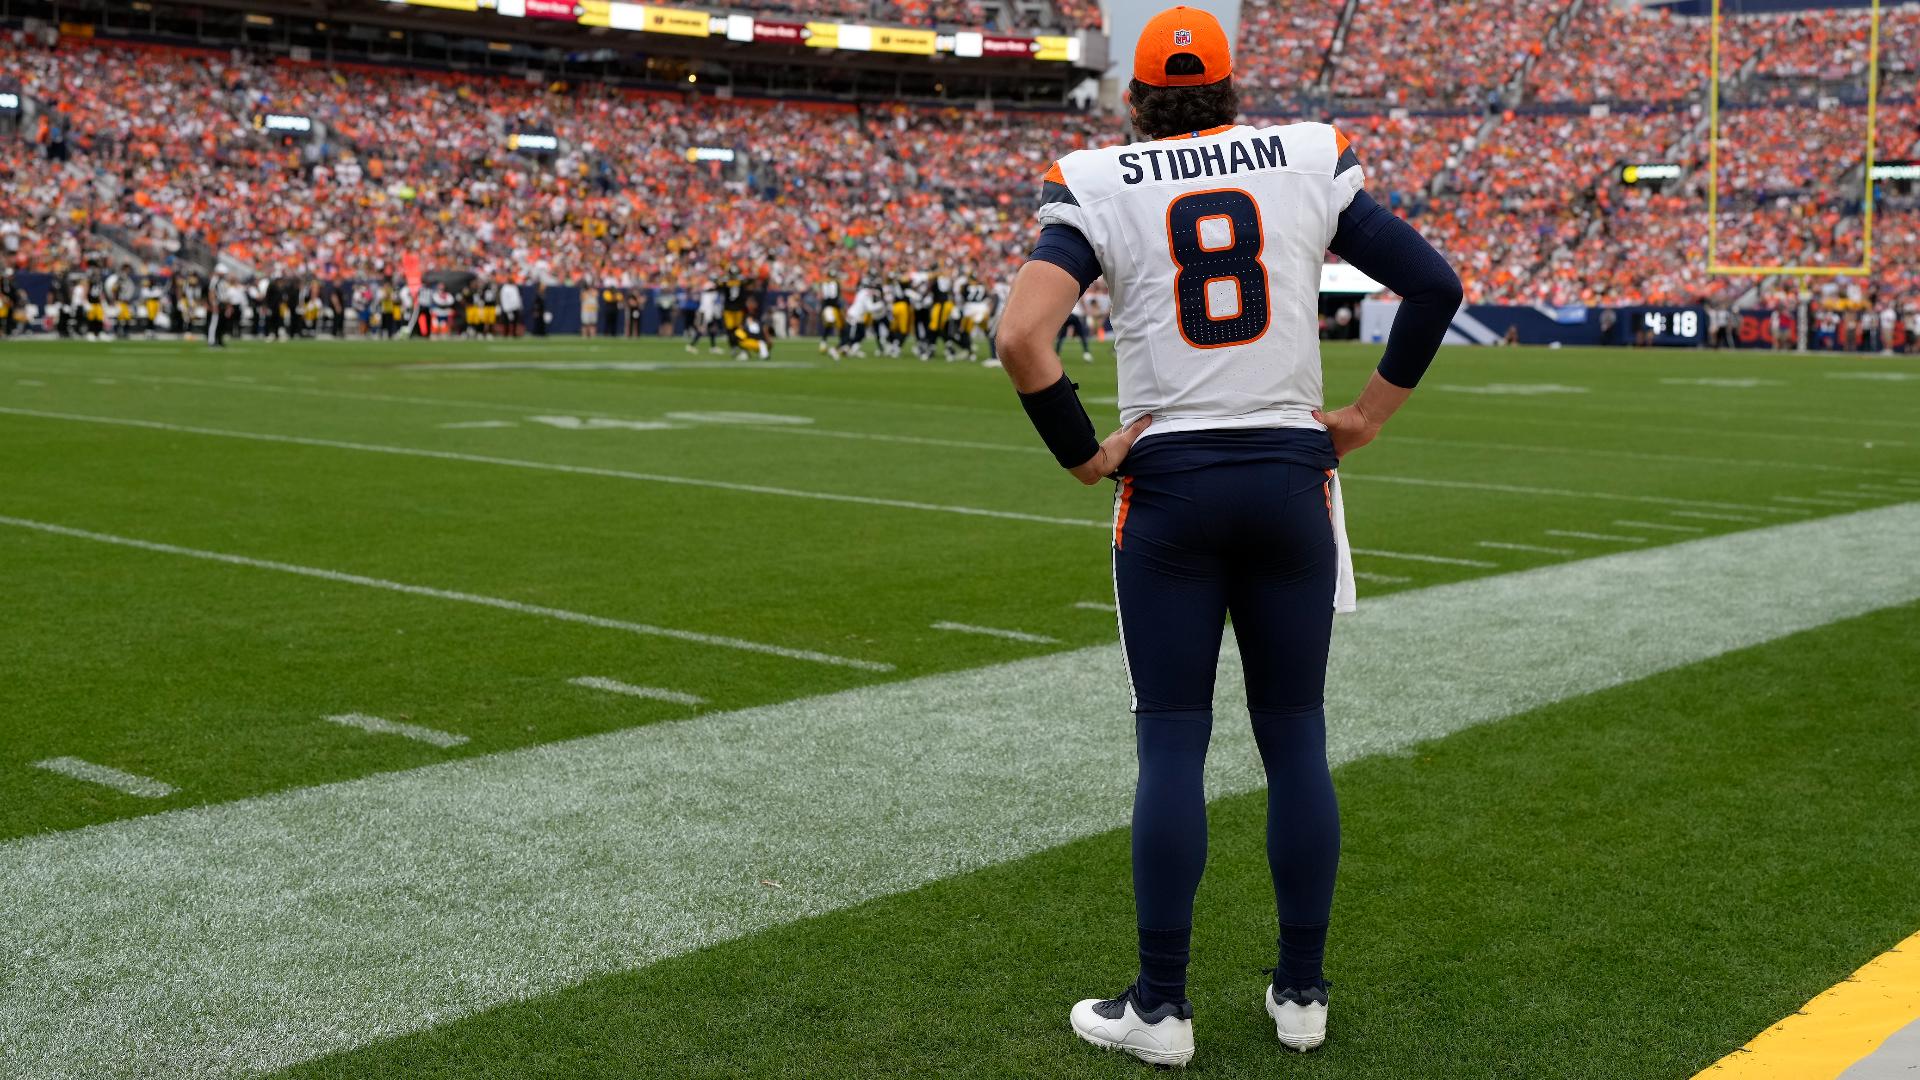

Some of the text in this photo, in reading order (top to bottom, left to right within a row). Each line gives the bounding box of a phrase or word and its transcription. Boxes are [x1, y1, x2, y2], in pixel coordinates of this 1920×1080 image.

[1119, 135, 1287, 185] STIDHAM
[1166, 187, 1271, 350] 8
[1645, 311, 1697, 337] 4:18
